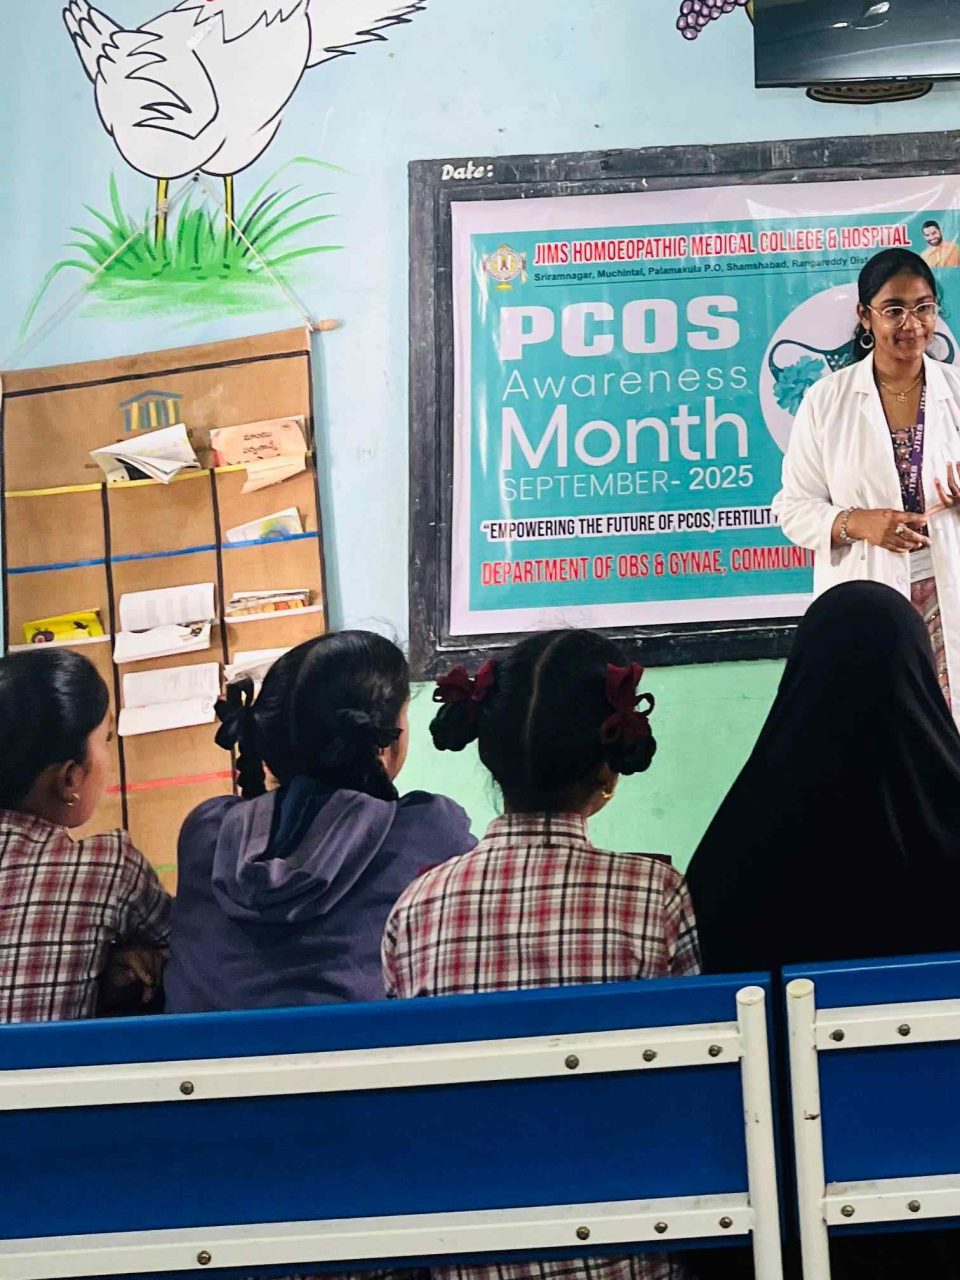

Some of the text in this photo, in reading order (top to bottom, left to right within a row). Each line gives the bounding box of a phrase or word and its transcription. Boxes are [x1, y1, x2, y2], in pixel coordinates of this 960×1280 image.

[441, 161, 494, 181] Date:
[534, 225, 912, 265] JIMS HOMOEOPATHIC MEDICAL COLLEGE & HOSPITAL
[597, 268, 646, 279] Muchintal,
[648, 264, 702, 275] Palamakula
[726, 260, 790, 271] Shamshabad,
[791, 257, 848, 269] Rangareddy
[500, 295, 740, 361] PCOS
[502, 366, 748, 401] Awareness
[501, 396, 749, 471] Month
[688, 464, 754, 491] 2025
[579, 517, 604, 535] THE
[607, 513, 655, 533] FUTURE
[658, 513, 674, 531] OF
[677, 510, 714, 530] PCOS,
[718, 507, 778, 527] FERTILIT
[482, 558, 588, 585] DEPARTMENT
[594, 556, 613, 579] OF
[619, 554, 650, 578] OBS
[654, 553, 665, 576] &
[669, 550, 727, 576] GYNAE,
